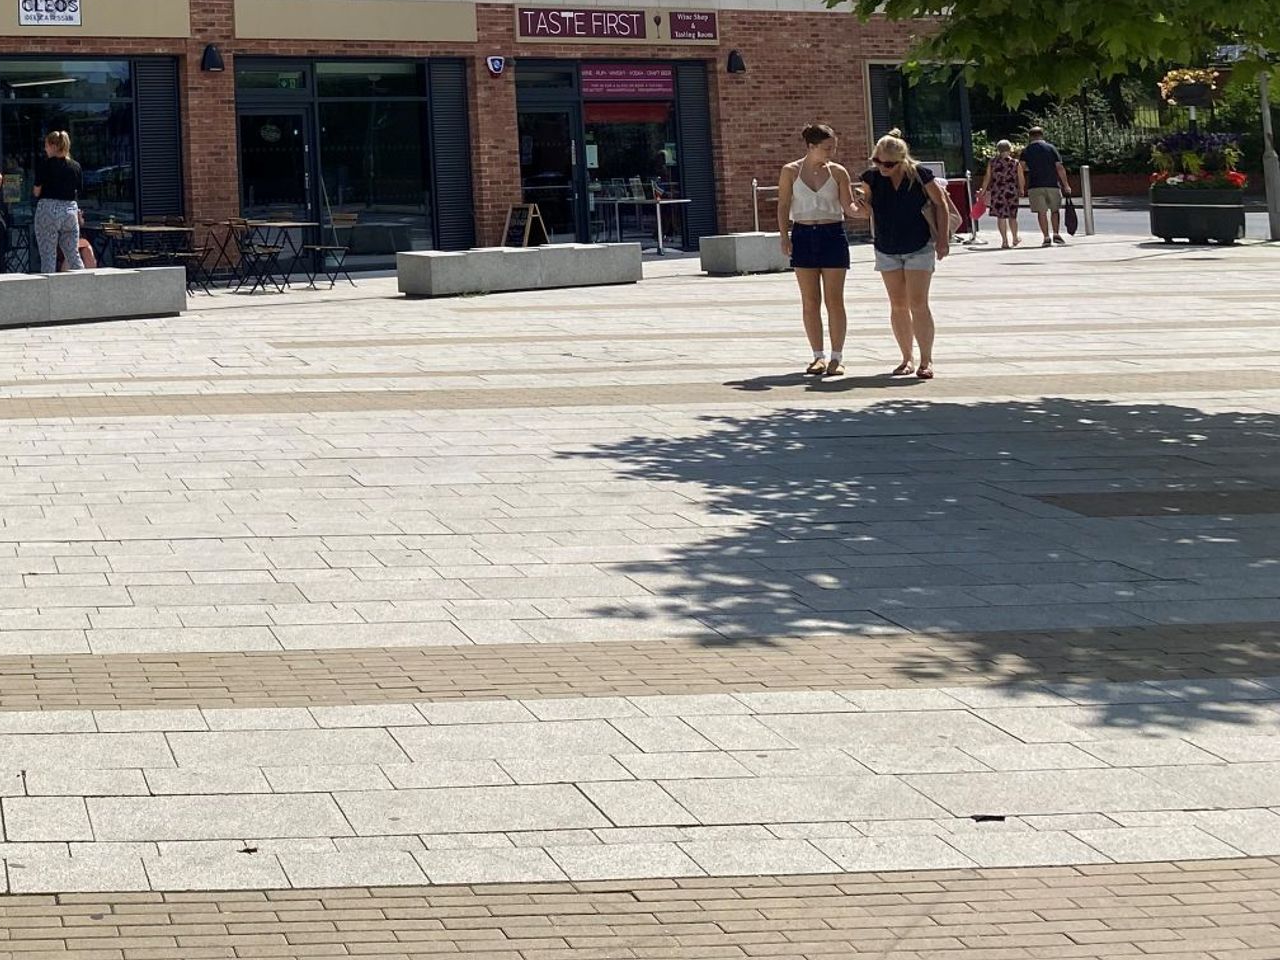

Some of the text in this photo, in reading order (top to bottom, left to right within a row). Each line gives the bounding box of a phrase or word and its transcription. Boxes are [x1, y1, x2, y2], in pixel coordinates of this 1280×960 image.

[523, 11, 640, 35] TASTE FIRST
[693, 13, 709, 22] Shop
